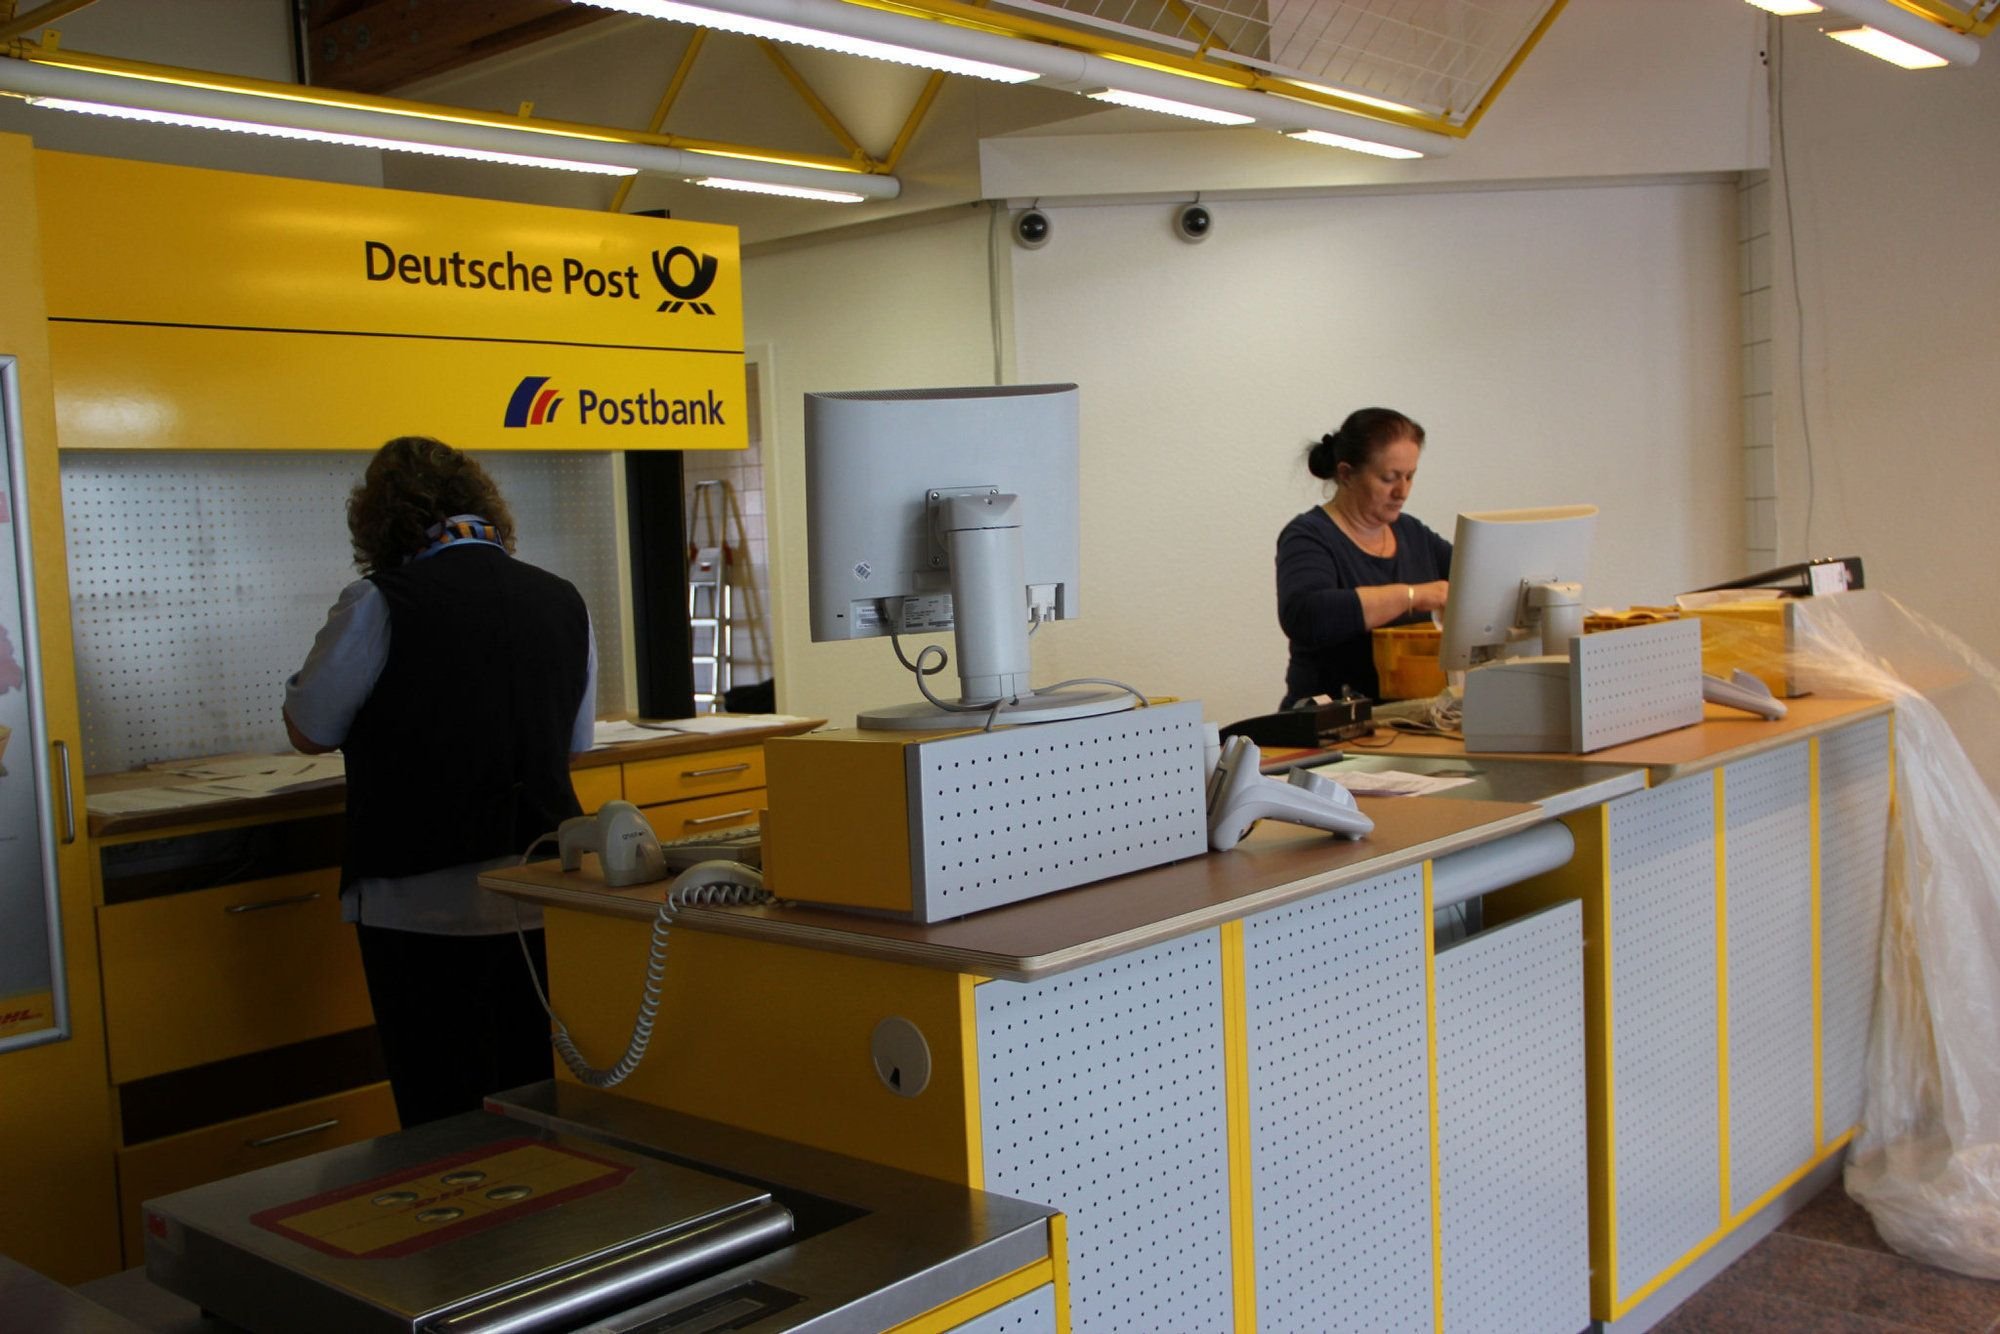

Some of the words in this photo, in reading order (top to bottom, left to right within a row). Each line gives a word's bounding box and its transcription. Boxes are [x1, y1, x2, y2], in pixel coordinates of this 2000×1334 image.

[365, 240, 553, 293] Deutsche
[563, 257, 640, 300] Post
[578, 388, 726, 426] Postbank
